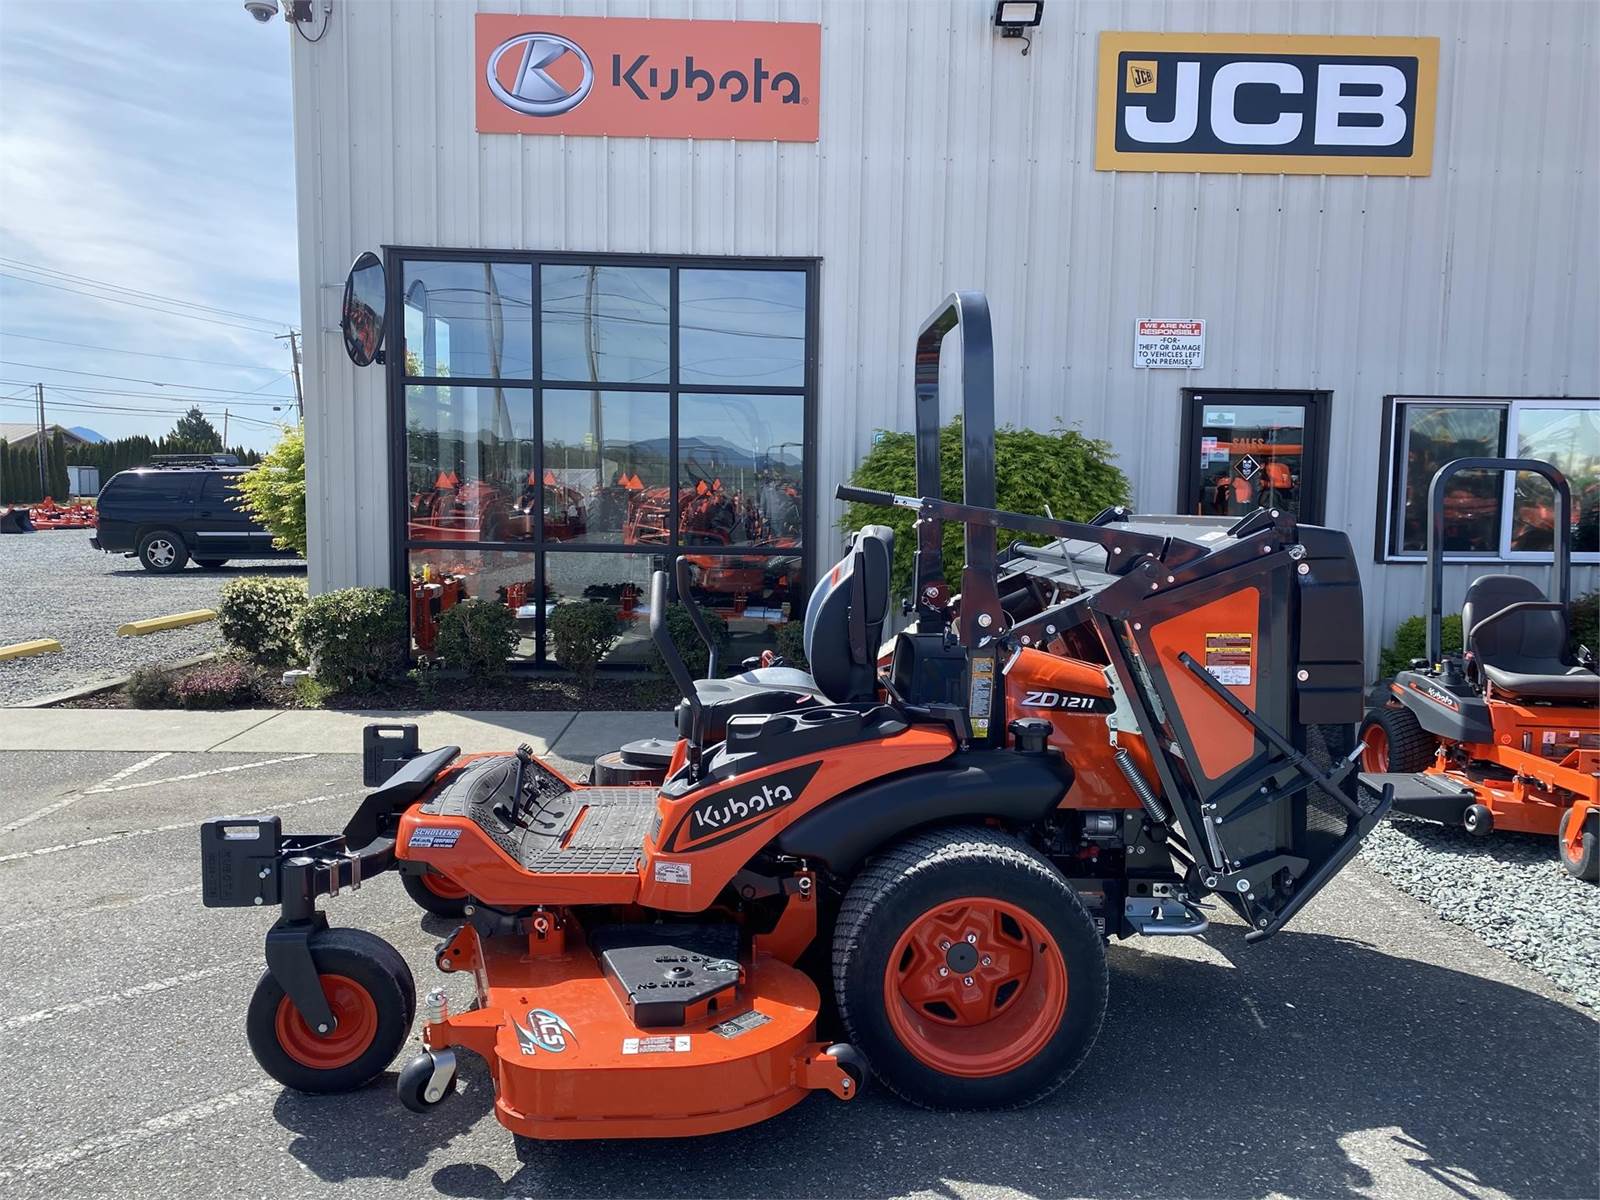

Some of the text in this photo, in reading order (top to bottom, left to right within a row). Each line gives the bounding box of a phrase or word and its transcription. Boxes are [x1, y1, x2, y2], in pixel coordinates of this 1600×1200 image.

[612, 54, 801, 104] Kubota
[1135, 67, 1154, 85] JCB
[1125, 62, 1407, 146] JCB
[1232, 438, 1265, 449] SALES
[1021, 691, 1095, 709] ZD 1211
[1428, 687, 1453, 705] Kubota
[695, 785, 793, 827] Kubota
[535, 1014, 566, 1046] ACS
[519, 1042, 536, 1055] 72
